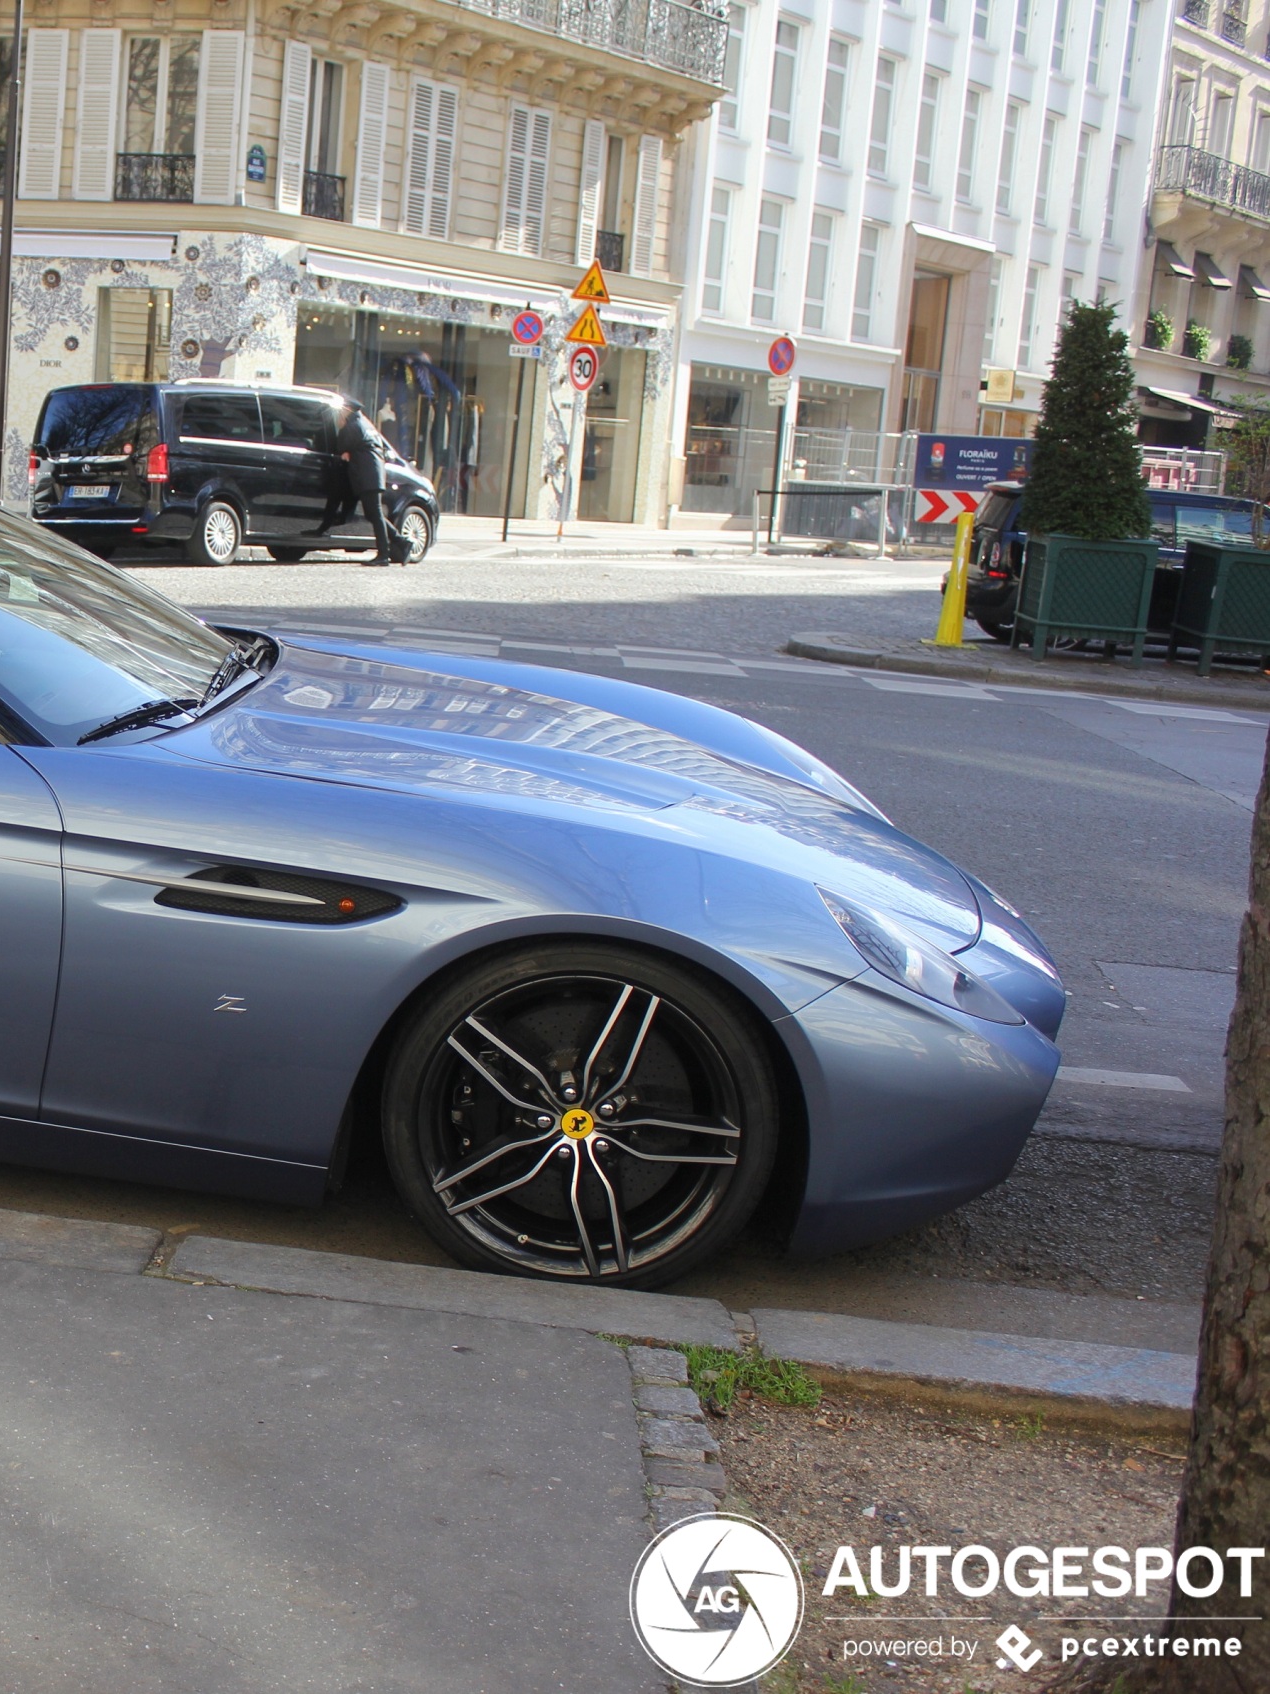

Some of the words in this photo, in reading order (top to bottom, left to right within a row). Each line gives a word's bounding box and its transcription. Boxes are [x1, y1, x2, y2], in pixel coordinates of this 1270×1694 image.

[511, 347, 531, 355] SAUF
[39, 359, 62, 368] DIOR
[574, 358, 592, 379] 30
[959, 449, 997, 459] FLORAÏKU
